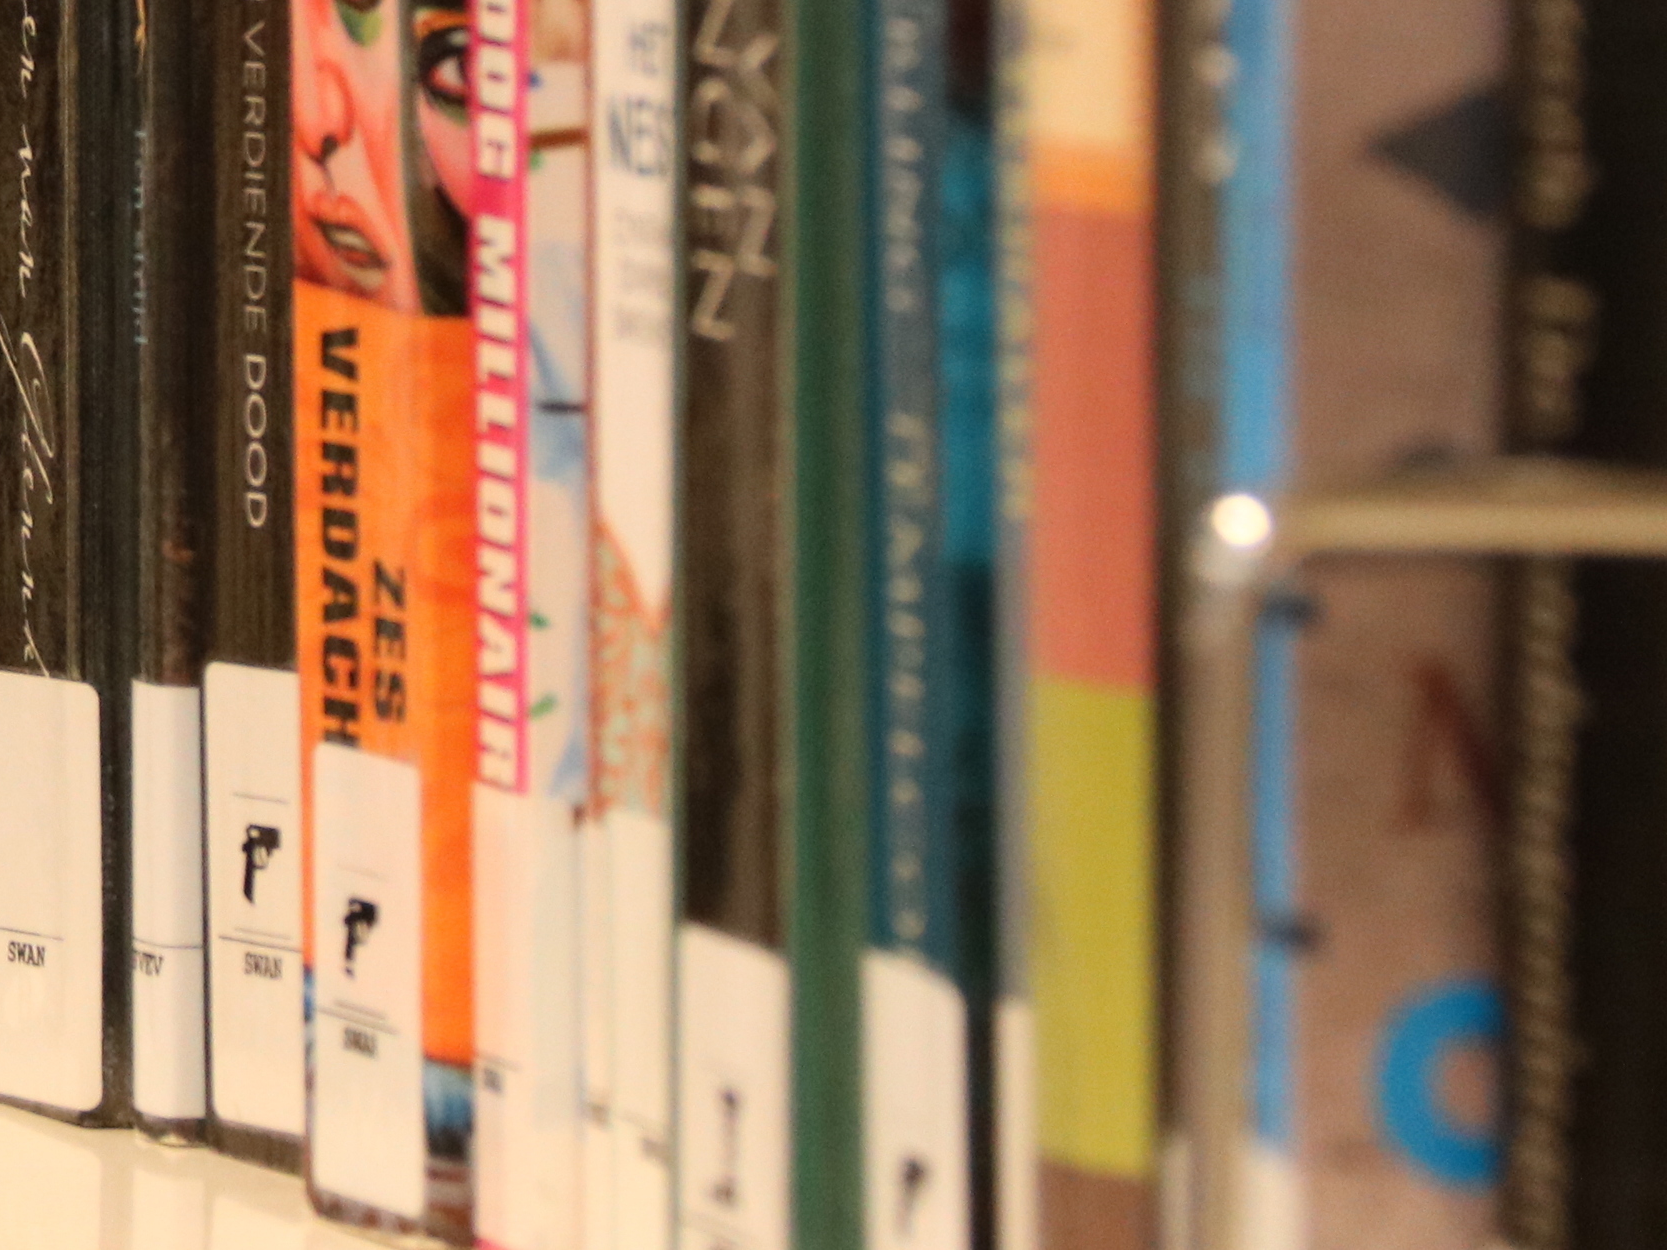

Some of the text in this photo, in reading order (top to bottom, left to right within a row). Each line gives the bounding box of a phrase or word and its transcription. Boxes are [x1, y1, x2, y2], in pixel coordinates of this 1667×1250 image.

[17, 123, 36, 299] van
[241, 21, 267, 333] VERDIENDE
[242, 354, 268, 530] DOOD
[373, 558, 407, 725] ZES
[6, 939, 47, 968] SWAN
[242, 951, 283, 981] SWAN
